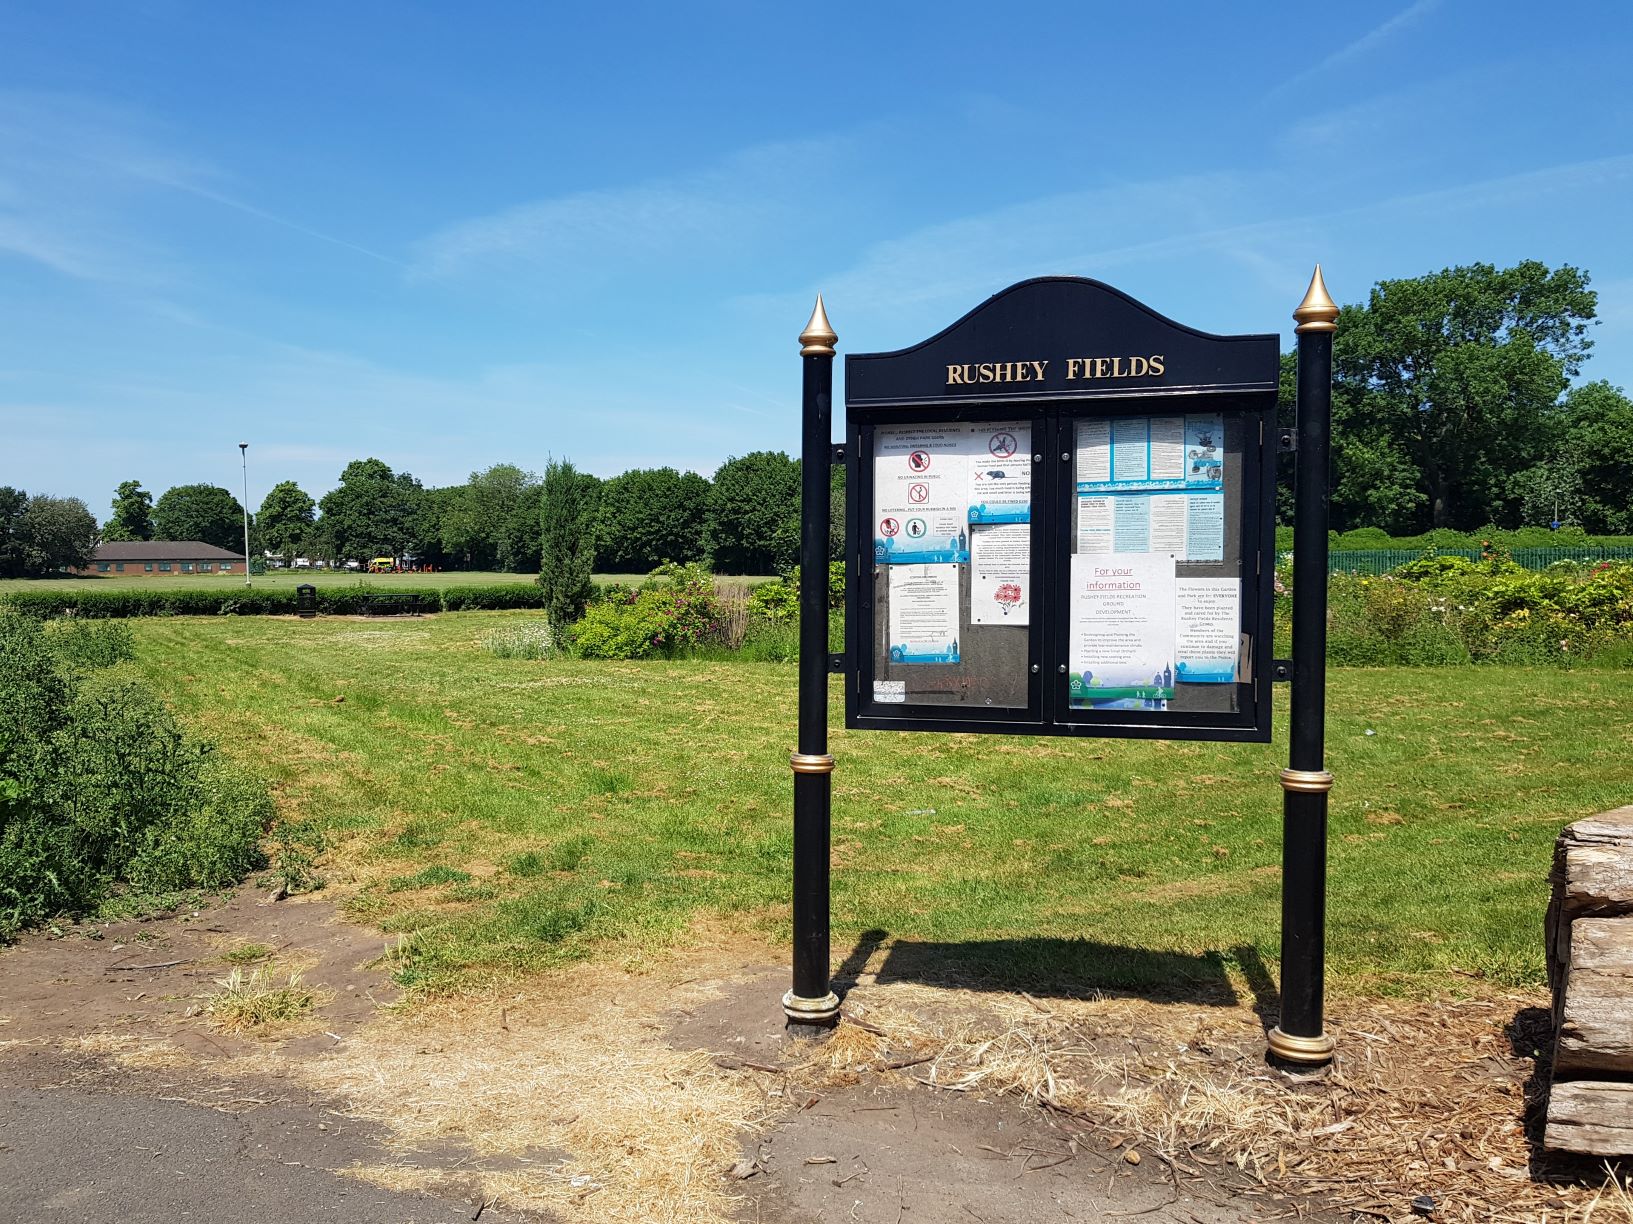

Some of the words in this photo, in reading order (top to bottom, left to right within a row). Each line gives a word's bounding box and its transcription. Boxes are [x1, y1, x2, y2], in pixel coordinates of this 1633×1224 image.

[946, 361, 1048, 384] RUSHEY
[1065, 355, 1165, 380] FIELDS
[1094, 567, 1109, 575] For
[1113, 568, 1133, 576] your
[1086, 581, 1141, 589] information
